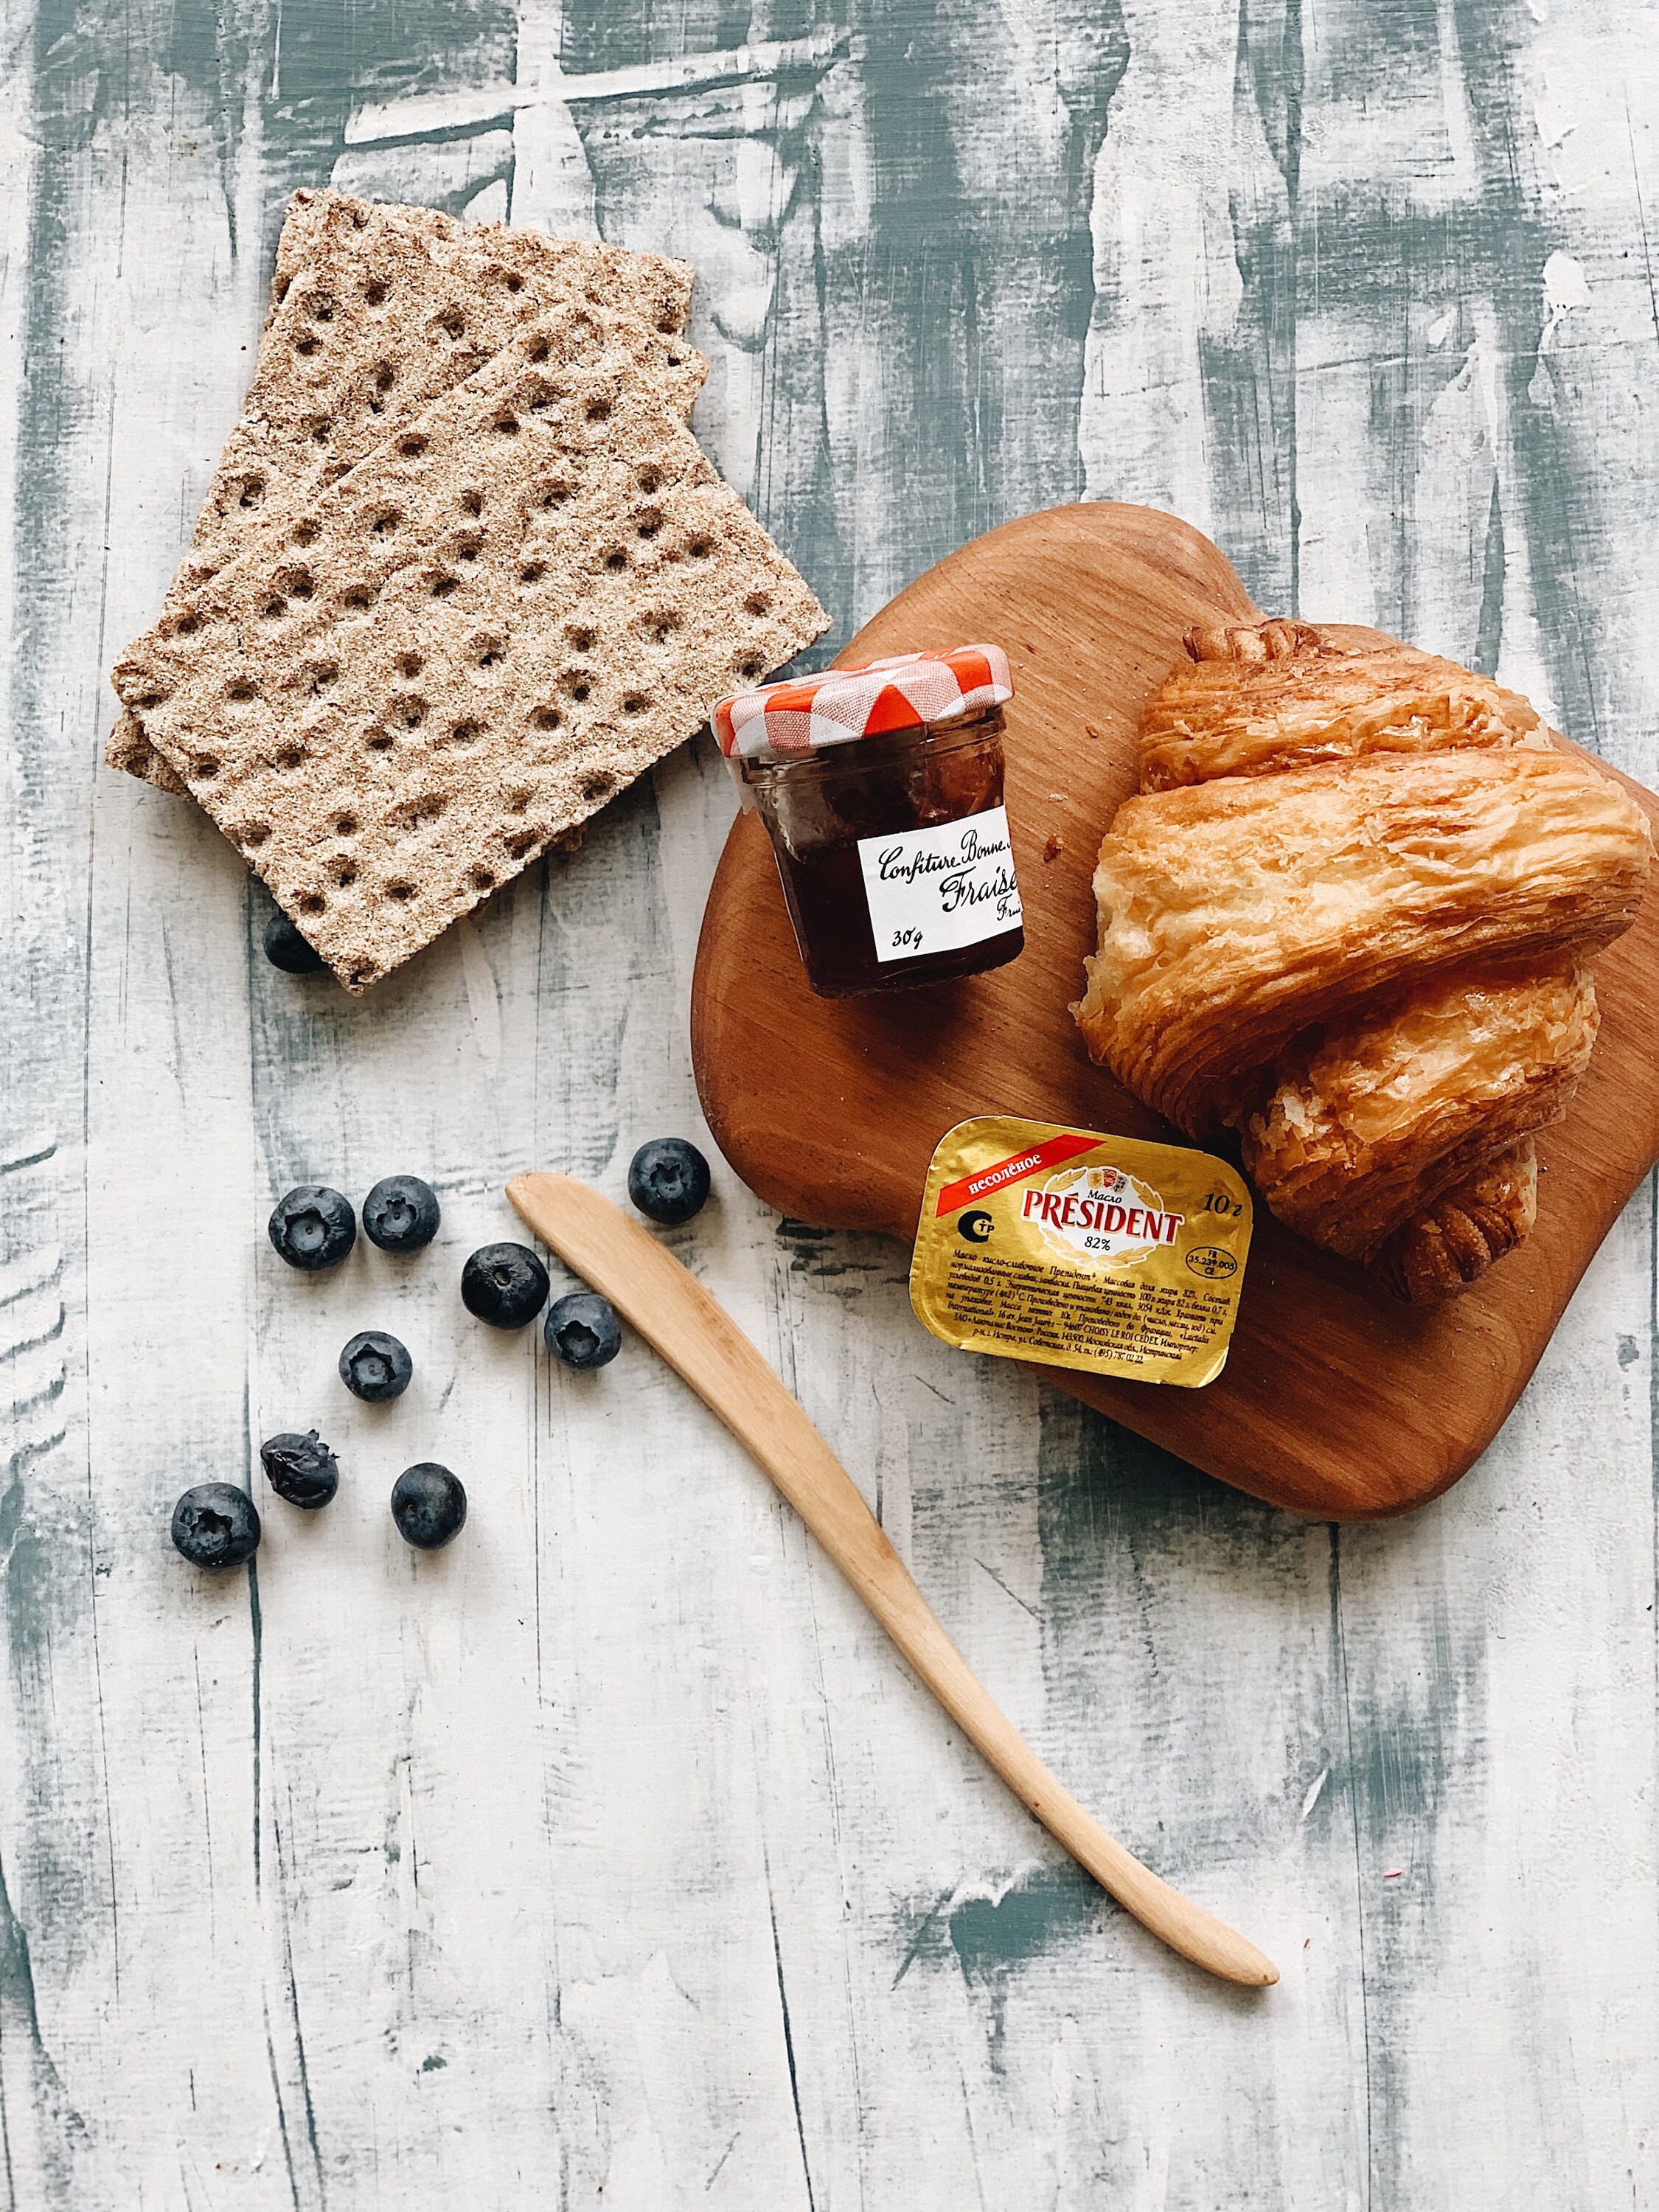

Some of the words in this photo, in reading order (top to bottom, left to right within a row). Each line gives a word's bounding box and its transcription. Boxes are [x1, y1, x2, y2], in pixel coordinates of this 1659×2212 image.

[892, 927, 923, 950] 30g
[969, 1152, 1042, 1195] несолёное
[1087, 1189, 1121, 1203] Масло
[1202, 1192, 1230, 1213] 10
[1023, 1189, 1184, 1244] PRÉSIDENT
[1084, 1236, 1110, 1251] 82%
[1208, 1250, 1217, 1258] FR
[953, 1249, 977, 1260] Масло
[982, 1256, 1044, 1273] кисло-сливочное
[1102, 1276, 1135, 1288] Массовая
[1139, 1281, 1155, 1291] доля
[1204, 1267, 1214, 1275] CE
[1026, 1293, 1068, 1308] Произведено
[1072, 1281, 1102, 1293] Пищевая
[1191, 1301, 1210, 1312] белка
[999, 1300, 1021, 1310] Масса
[1078, 1313, 1119, 1327] Произведено
[1083, 1324, 1108, 1336] CHOISY
[1085, 1335, 1123, 1349] Московская
